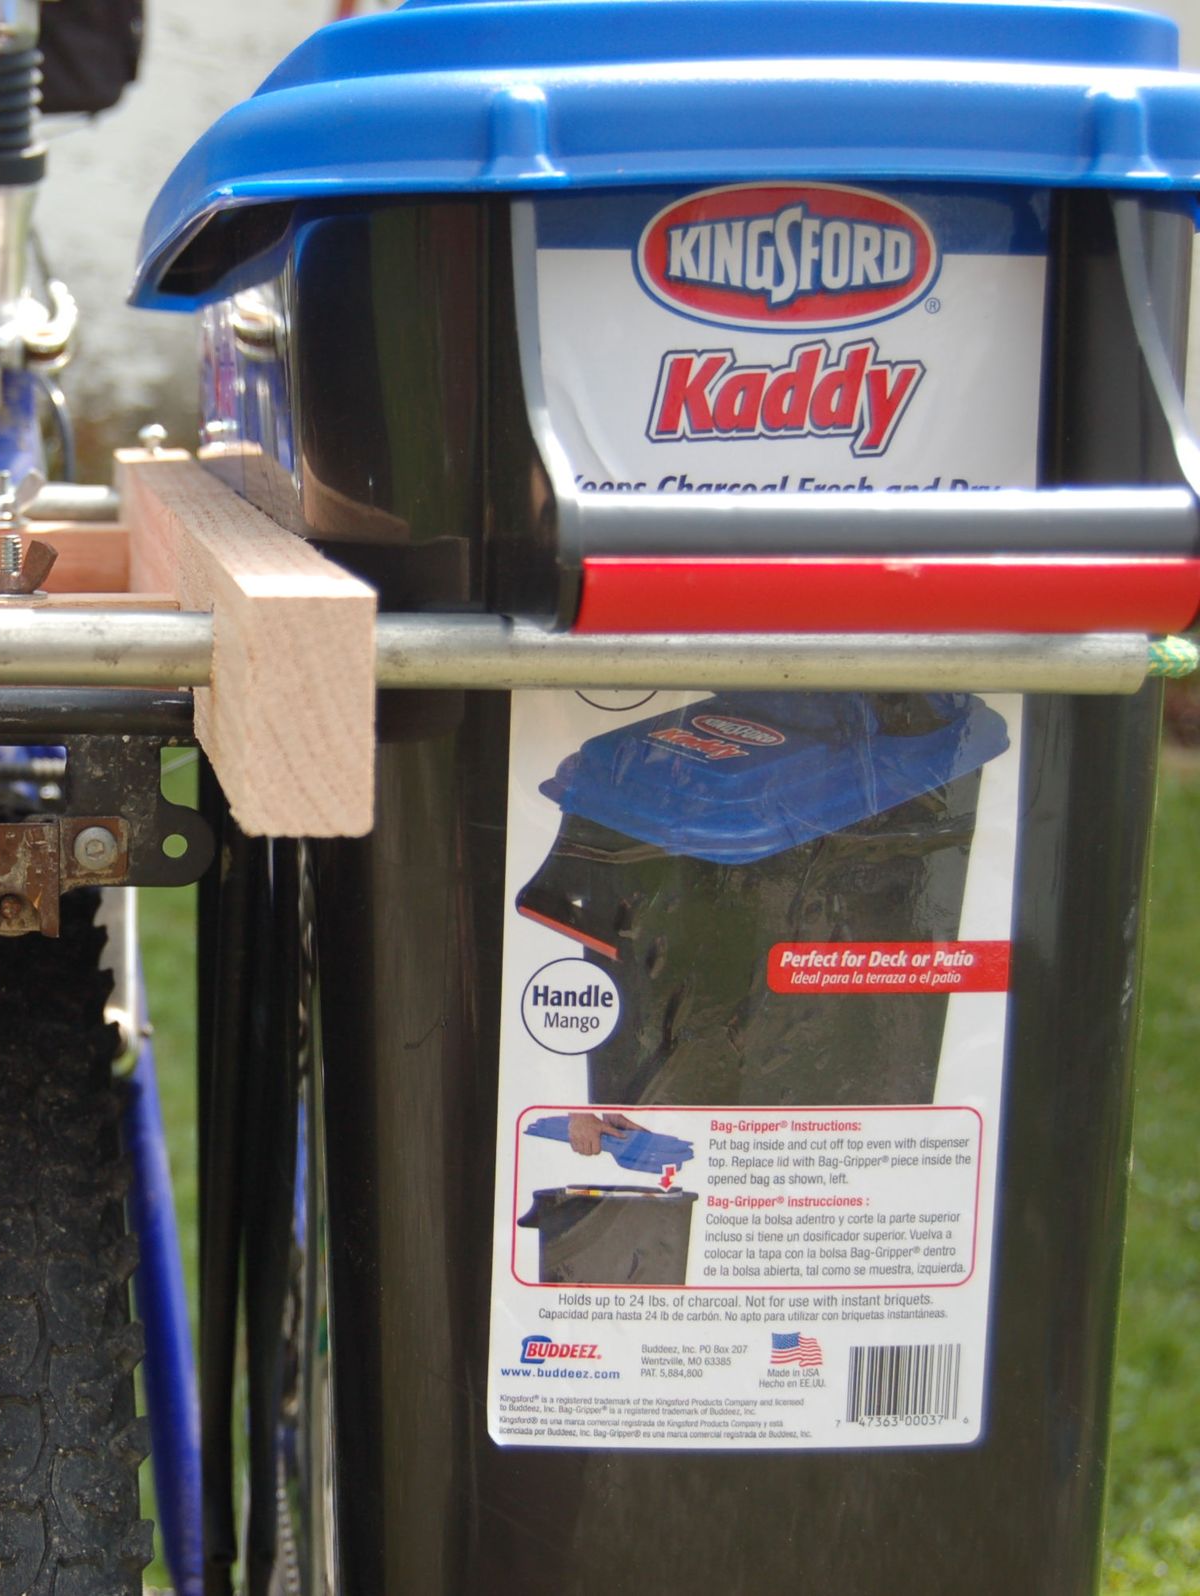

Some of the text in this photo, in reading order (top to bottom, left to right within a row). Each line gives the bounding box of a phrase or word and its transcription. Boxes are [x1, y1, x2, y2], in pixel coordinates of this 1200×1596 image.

[669, 205, 911, 303] KINGSFORD
[650, 339, 923, 456] Kaddy
[781, 950, 973, 967] Perfect for Deck or Patio
[790, 971, 962, 986] Ideal para la terraza o el patio
[532, 985, 613, 1008] Handle
[544, 1011, 599, 1033] Mango
[709, 1136, 969, 1152] Put bag inside and cut off top even with dispenser
[731, 1156, 774, 1170] Replace
[776, 1156, 789, 1167] lid
[792, 1156, 814, 1167] with
[890, 1154, 918, 1167] piece
[921, 1154, 952, 1165] inside
[955, 1154, 971, 1164] the
[707, 1173, 746, 1186] opened
[750, 1173, 769, 1187] bag
[772, 1175, 785, 1184] as
[787, 1195, 863, 1207] instrucciones
[705, 1212, 960, 1227] Coloque la bolsa adentro y corte la parte superior
[705, 1230, 742, 1242] incluso
[745, 1231, 754, 1241] si
[757, 1231, 783, 1242] tiene
[786, 1232, 799, 1242] un
[802, 1230, 860, 1242] dosificador
[909, 1228, 942, 1240] Vuelva
[945, 1230, 952, 1239] a
[704, 1247, 743, 1259] colocar
[746, 1248, 755, 1259] la
[758, 1248, 781, 1261] tapa
[784, 1249, 803, 1259] con
[806, 1248, 816, 1258] la
[819, 1247, 847, 1258] bolsa
[923, 1245, 956, 1256] dentro
[703, 1265, 716, 1276] de
[720, 1264, 729, 1276] la
[732, 1264, 760, 1276] bolsa
[806, 1265, 818, 1275] tal
[821, 1266, 850, 1275] como
[853, 1266, 866, 1275] se
[558, 1293, 591, 1305] Holds
[595, 1296, 610, 1308] up
[614, 1294, 625, 1306] to
[629, 1294, 644, 1306] 24
[672, 1294, 684, 1307] of
[745, 1295, 765, 1307] Not
[768, 1295, 785, 1307] for
[788, 1297, 809, 1307] use
[813, 1294, 837, 1306] with
[841, 1294, 880, 1306] instant
[501, 1367, 620, 1379] www.buddeez.com
[767, 1367, 819, 1377] Made in USA
[858, 1415, 899, 1427] 47363
[904, 1414, 945, 1426] 00037
